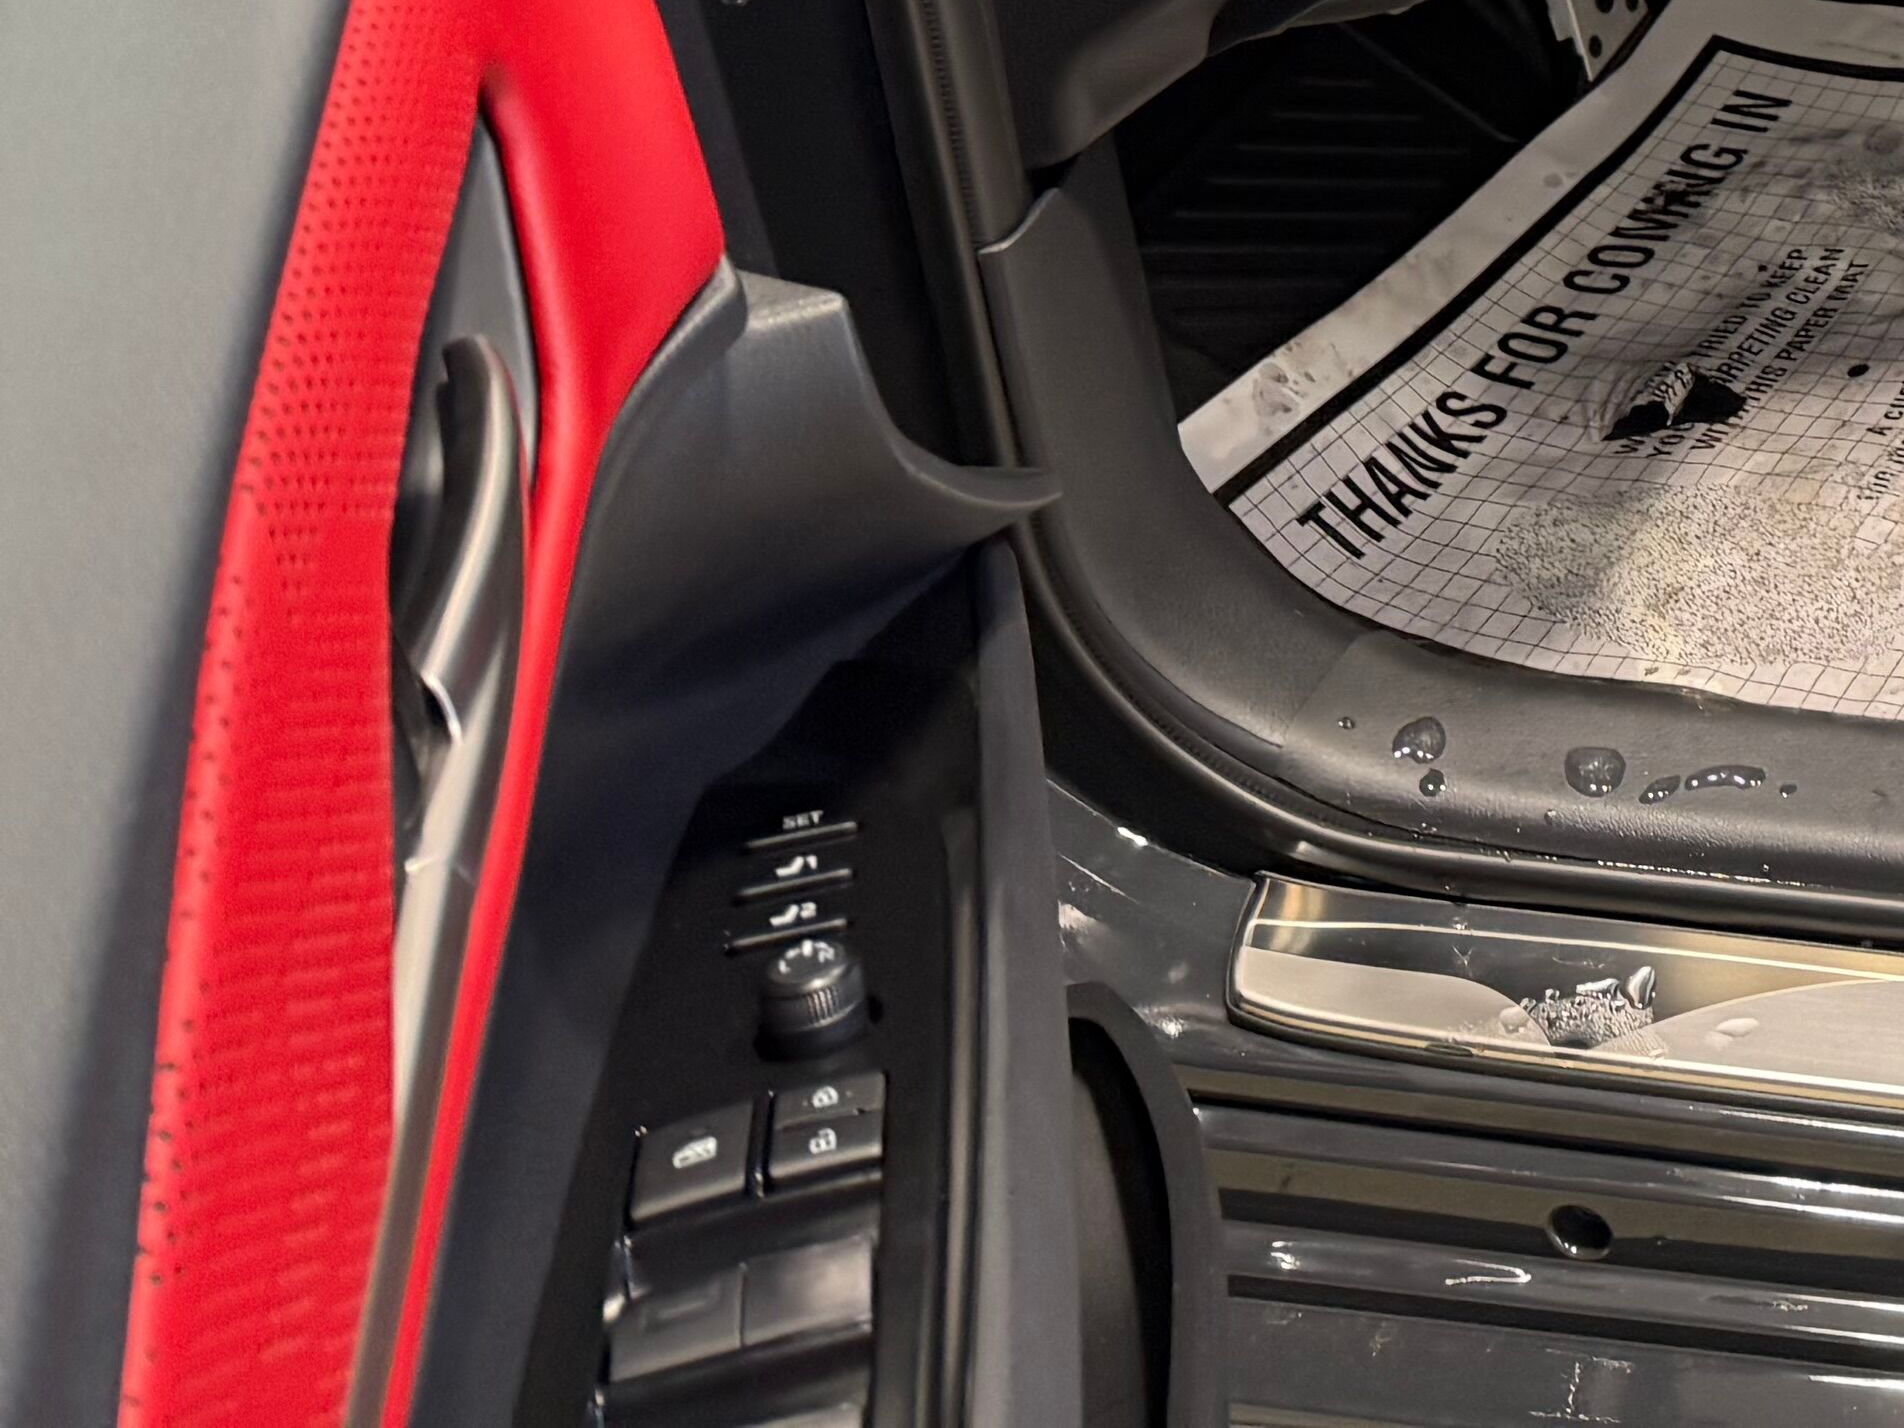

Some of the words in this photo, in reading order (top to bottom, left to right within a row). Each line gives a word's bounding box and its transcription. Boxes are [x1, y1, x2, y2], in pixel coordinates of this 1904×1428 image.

[1296, 391, 1507, 559] THANKS
[1471, 305, 1598, 390] FOR
[1562, 143, 1748, 295] COMING
[1711, 90, 1793, 133] IN
[1684, 315, 1748, 358] TRIED
[1737, 291, 1771, 309] TO
[1761, 248, 1808, 289] KEEP
[1709, 307, 1797, 384] ARPETING
[1786, 247, 1845, 305] CLEAN
[1775, 307, 1838, 362] PAPER
[1828, 261, 1869, 301] MAT
[783, 810, 823, 830] SET
[800, 901, 817, 919] 2
